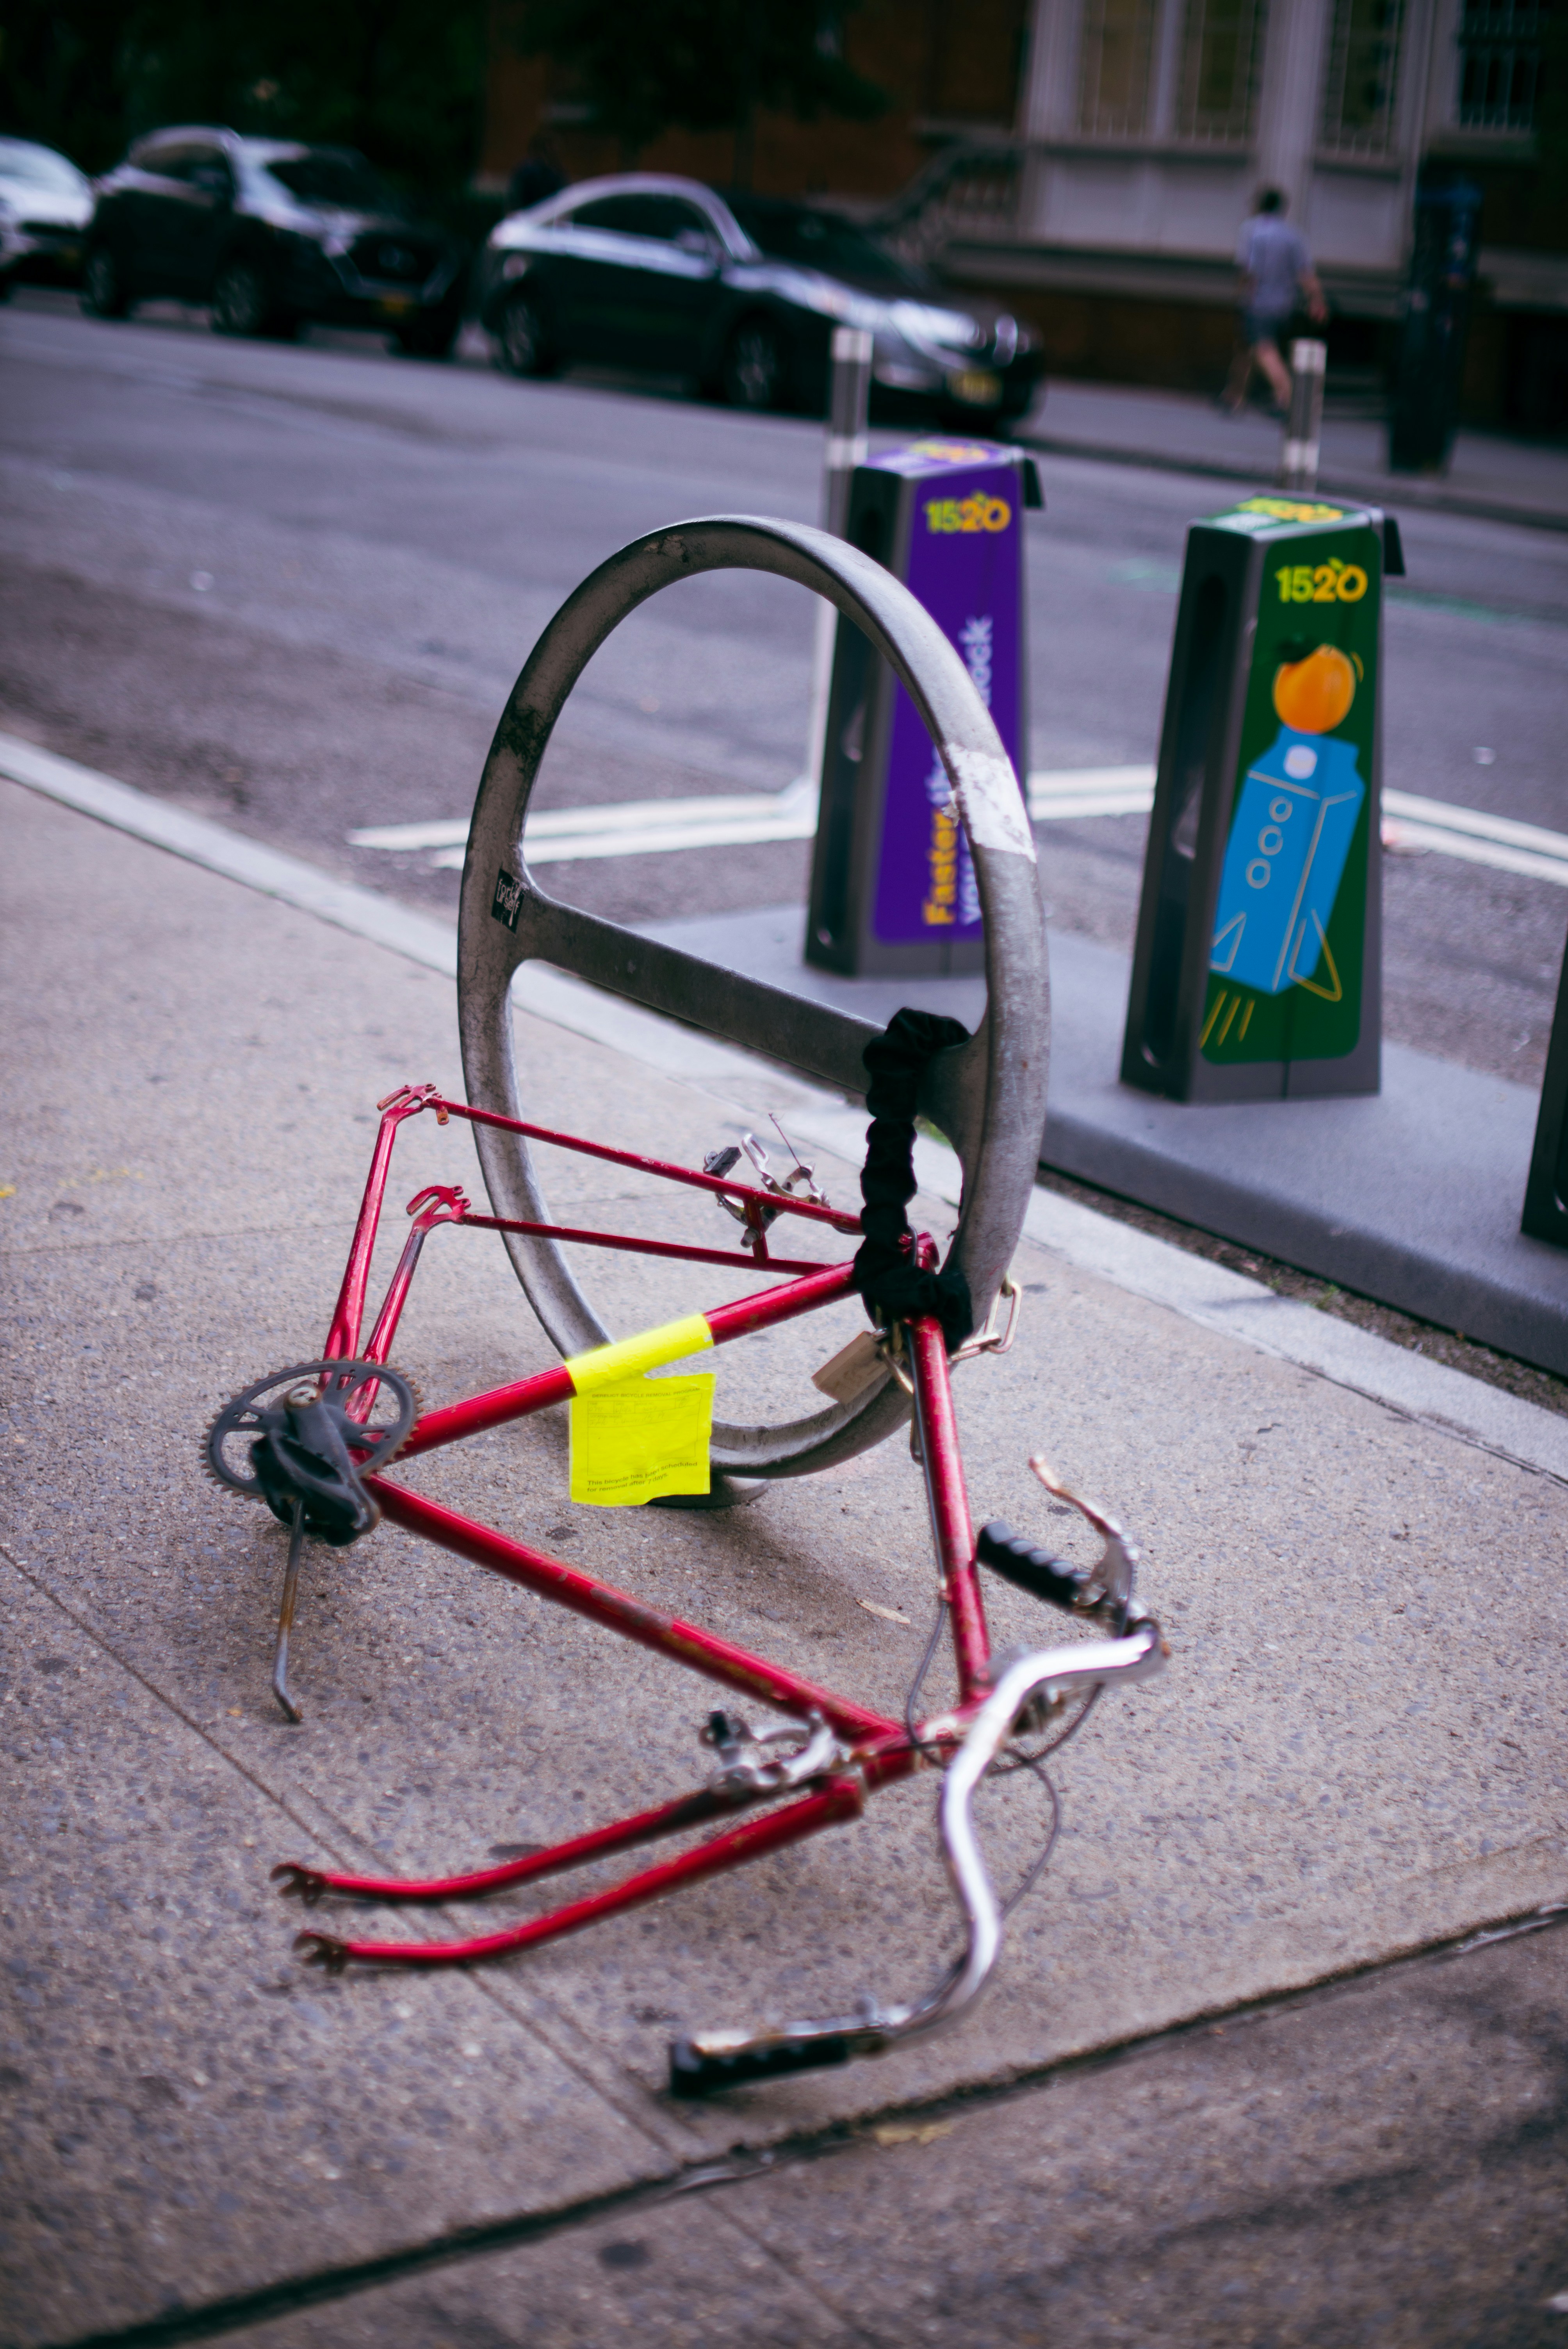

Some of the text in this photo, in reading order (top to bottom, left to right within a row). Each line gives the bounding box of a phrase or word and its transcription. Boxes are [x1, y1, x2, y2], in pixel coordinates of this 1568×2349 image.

[925, 495, 1011, 533] 1520
[1275, 562, 1368, 603] 1520
[923, 807, 958, 925] Faster
[498, 879, 515, 900] fork
[599, 1483, 627, 1491] removal
[653, 1472, 668, 1481] days.
[645, 1468, 659, 1478] been
[661, 1462, 698, 1470] scheduled
